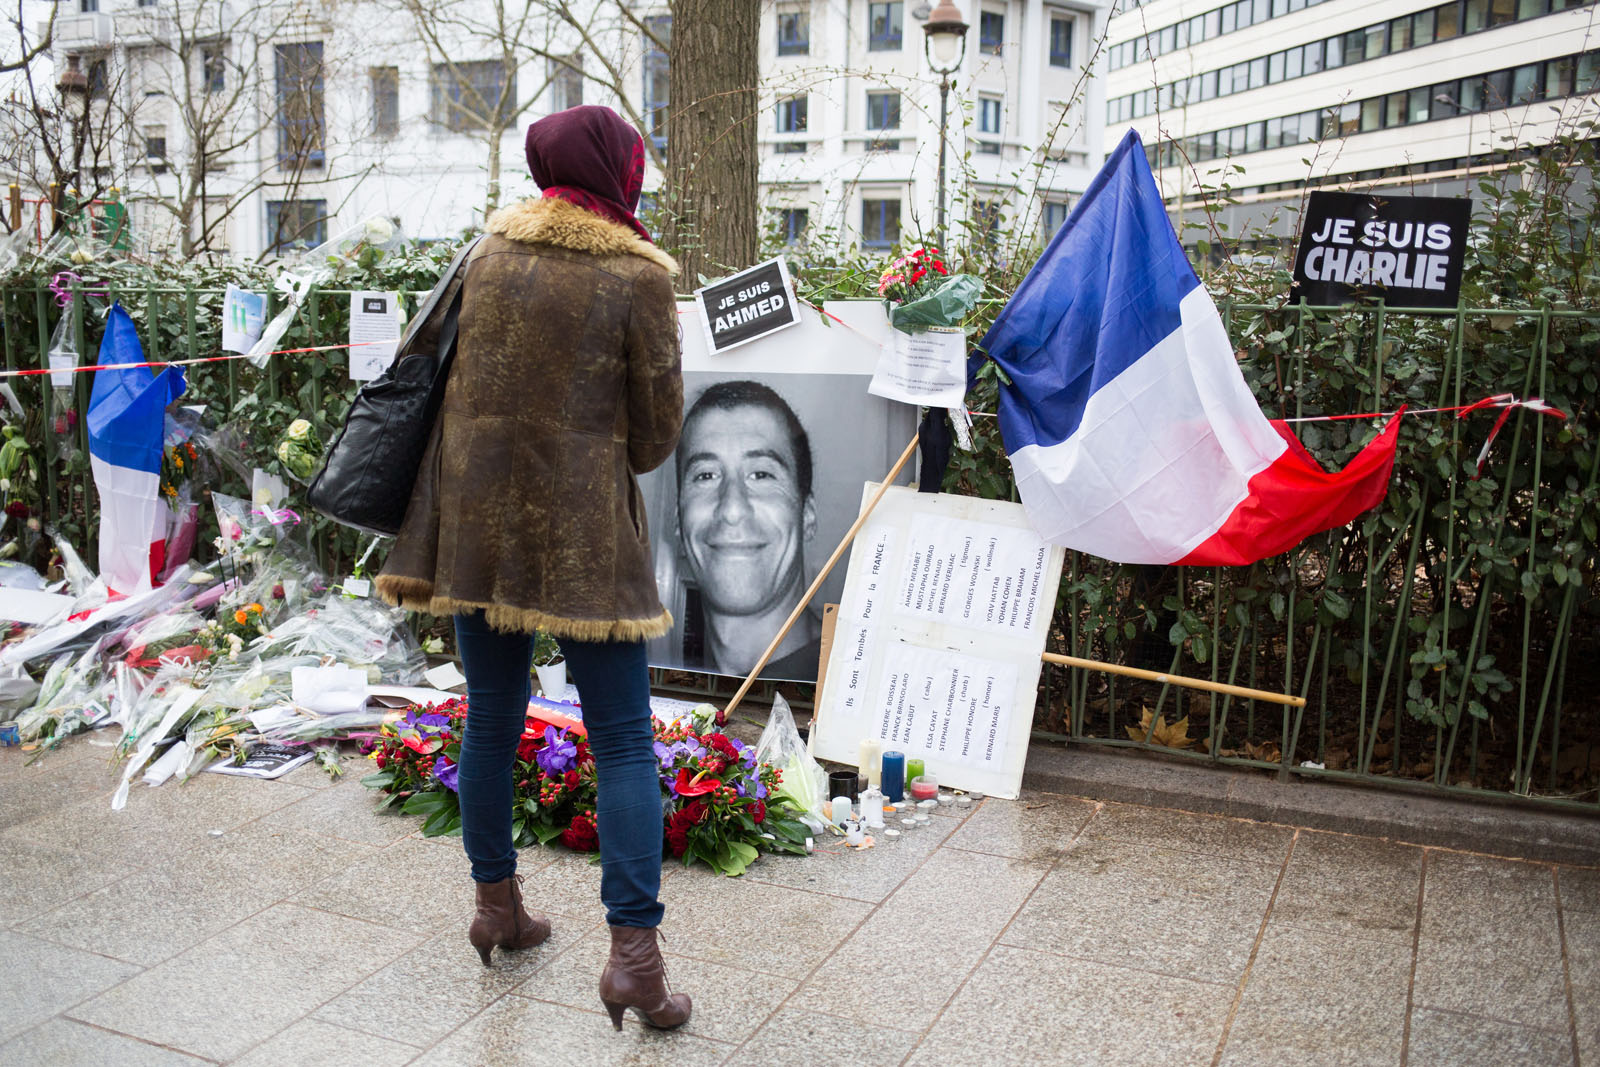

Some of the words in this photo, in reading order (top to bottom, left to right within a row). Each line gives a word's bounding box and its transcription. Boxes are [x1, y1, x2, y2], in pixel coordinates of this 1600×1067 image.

[1311, 218, 1356, 245] JE
[1361, 221, 1451, 250] SUIS
[1304, 246, 1450, 291] CHARLIE
[715, 294, 785, 333] AHMED
[718, 297, 736, 310] JE
[738, 281, 770, 303] SUIS
[868, 583, 877, 591] la
[905, 582, 915, 608] AHMED
[910, 551, 922, 582] MERABET
[916, 573, 929, 610] MUSTAPHA
[927, 588, 937, 612] MICHEL
[933, 558, 943, 587] RENAUD
[938, 582, 950, 614] BERNARD
[945, 553, 957, 582] VERLHAC
[964, 587, 975, 619] GEORGES
[970, 555, 981, 587] WOLINSKI
[990, 576, 1001, 603] HATTAB
[1010, 598, 1021, 627] PHILIPPE
[1016, 567, 1027, 598] BRAHAM
[1024, 596, 1036, 630] FRANCOIS
[1031, 571, 1041, 596] MICHEL
[1036, 547, 1046, 570] SAADA
[863, 598, 873, 619] Pour
[987, 603, 995, 622] YOAV
[998, 600, 1008, 625] YOHAN
[1003, 576, 1013, 600] COHEN
[849, 670, 860, 690] Sont
[887, 673, 898, 706] BOISSEAU
[846, 697, 854, 707] Ils
[892, 715, 902, 742] FRANCK
[897, 672, 910, 715] BRINSOLARO
[906, 703, 916, 727] CABUT
[929, 709, 938, 732] CAYAT
[939, 717, 951, 752] STEPHANE
[946, 668, 959, 717] CHARBONNIER
[926, 732, 935, 749] ELSA
[962, 727, 972, 757] PHILIPPE
[967, 697, 978, 727] HONORE
[986, 728, 997, 761] BERNARD
[992, 705, 1001, 728] MARIS
